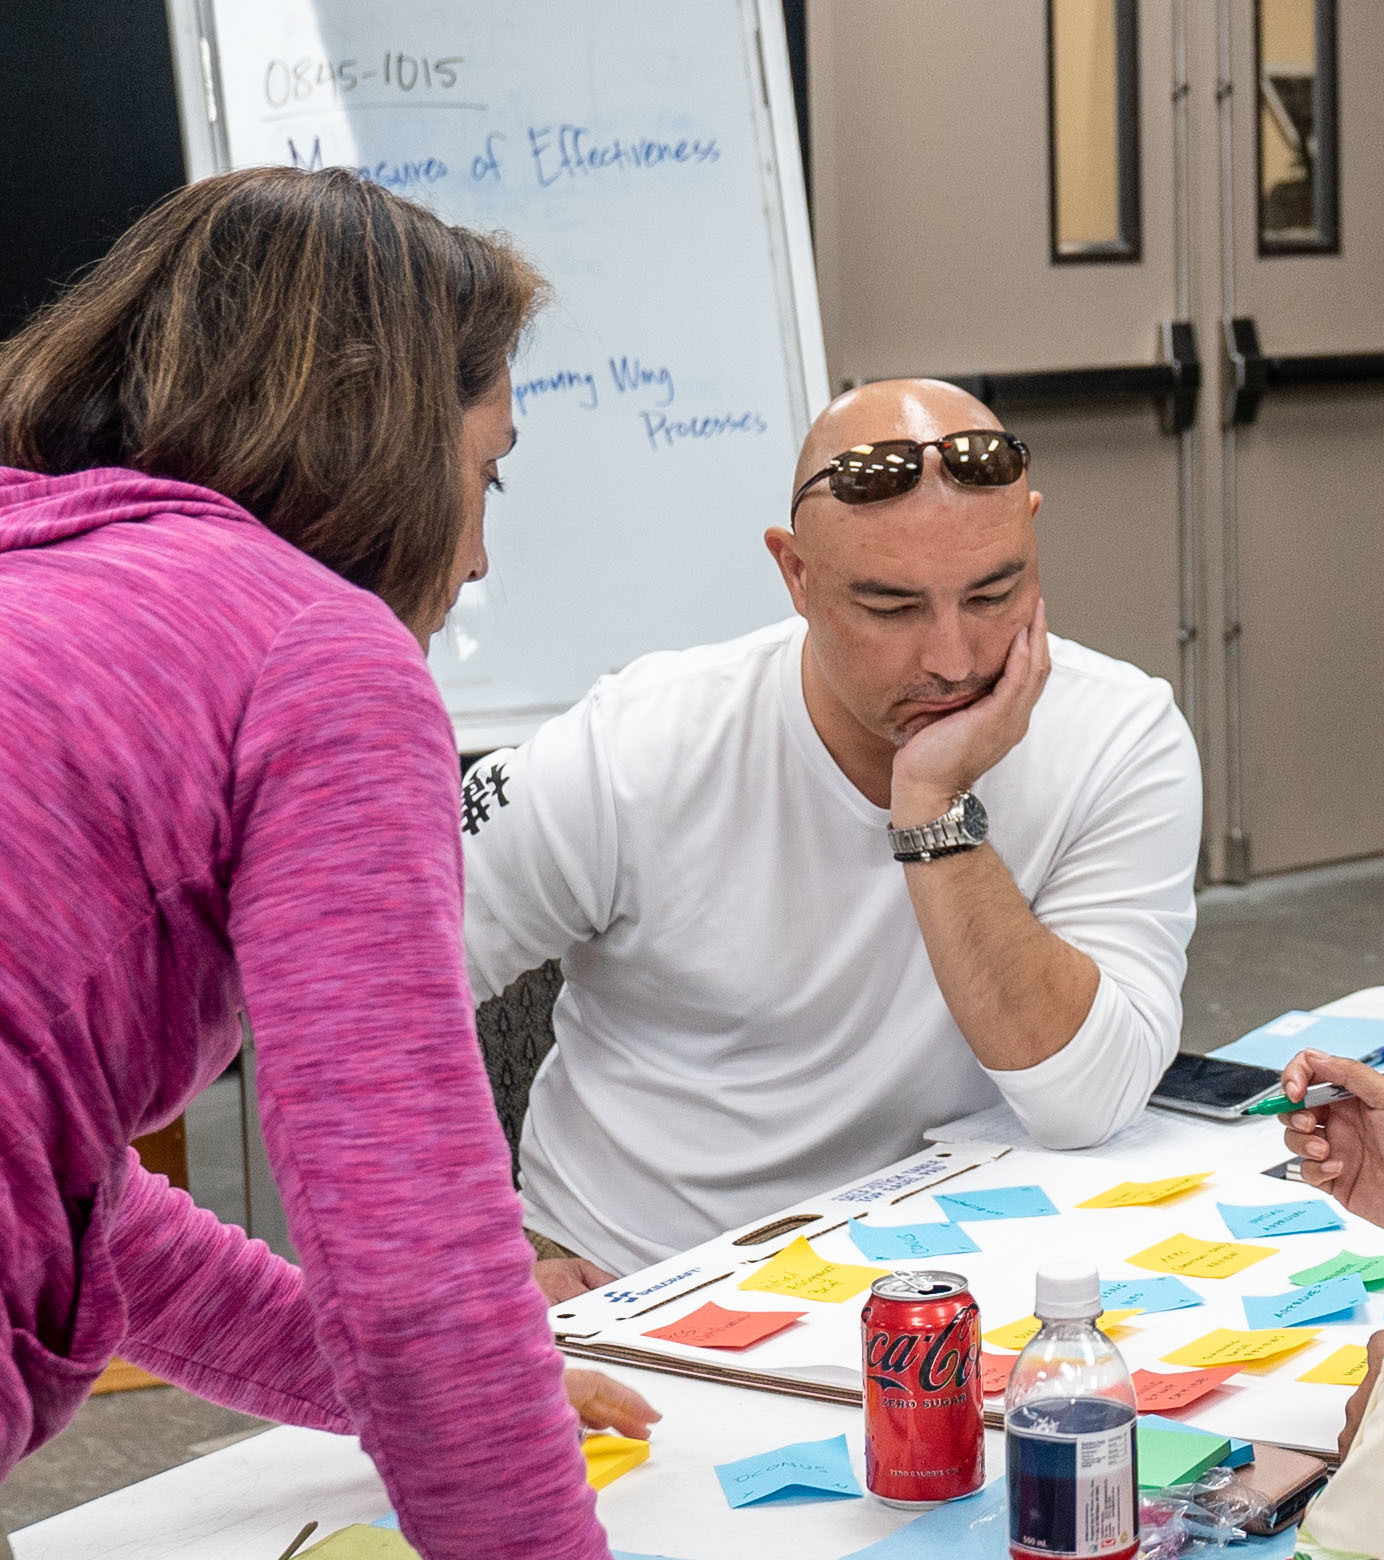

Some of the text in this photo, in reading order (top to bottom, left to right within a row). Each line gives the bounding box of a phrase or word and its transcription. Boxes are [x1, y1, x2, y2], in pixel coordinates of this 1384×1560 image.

[264, 50, 465, 108] 0845-1015
[287, 123, 721, 189] Masures of Effectiveness
[609, 355, 675, 407] Wing
[640, 409, 768, 450] Processes
[882, 1392, 967, 1410] ZERO SUGAR
